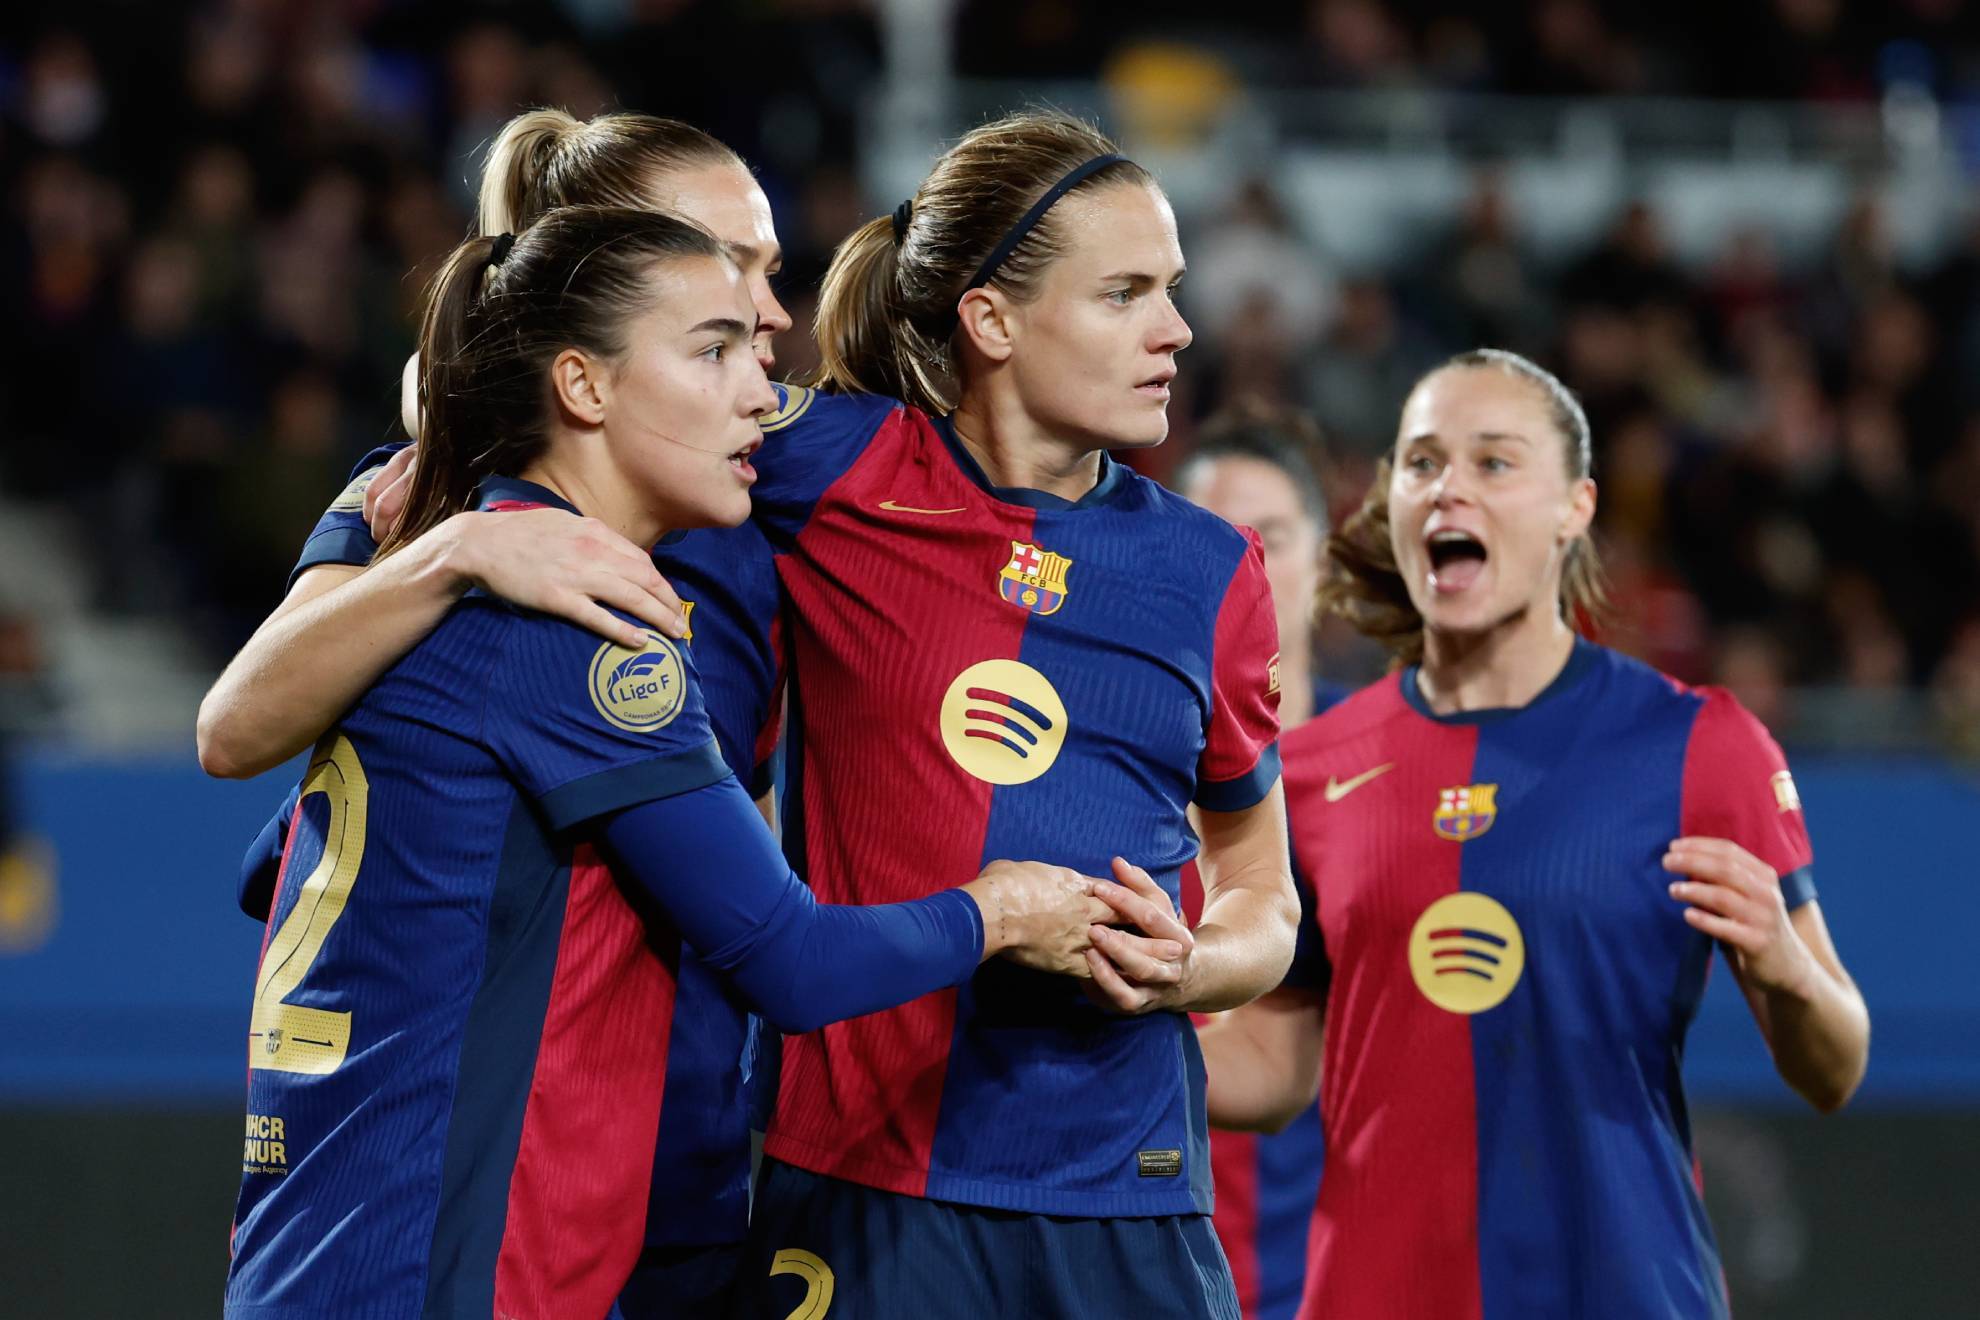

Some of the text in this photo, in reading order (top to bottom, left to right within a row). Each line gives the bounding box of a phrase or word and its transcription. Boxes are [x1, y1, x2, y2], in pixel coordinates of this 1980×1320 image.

[1021, 574, 1047, 588] FCB
[619, 674, 669, 702] Liga F
[246, 1114, 285, 1140] HCR
[244, 1139, 287, 1164] NUR
